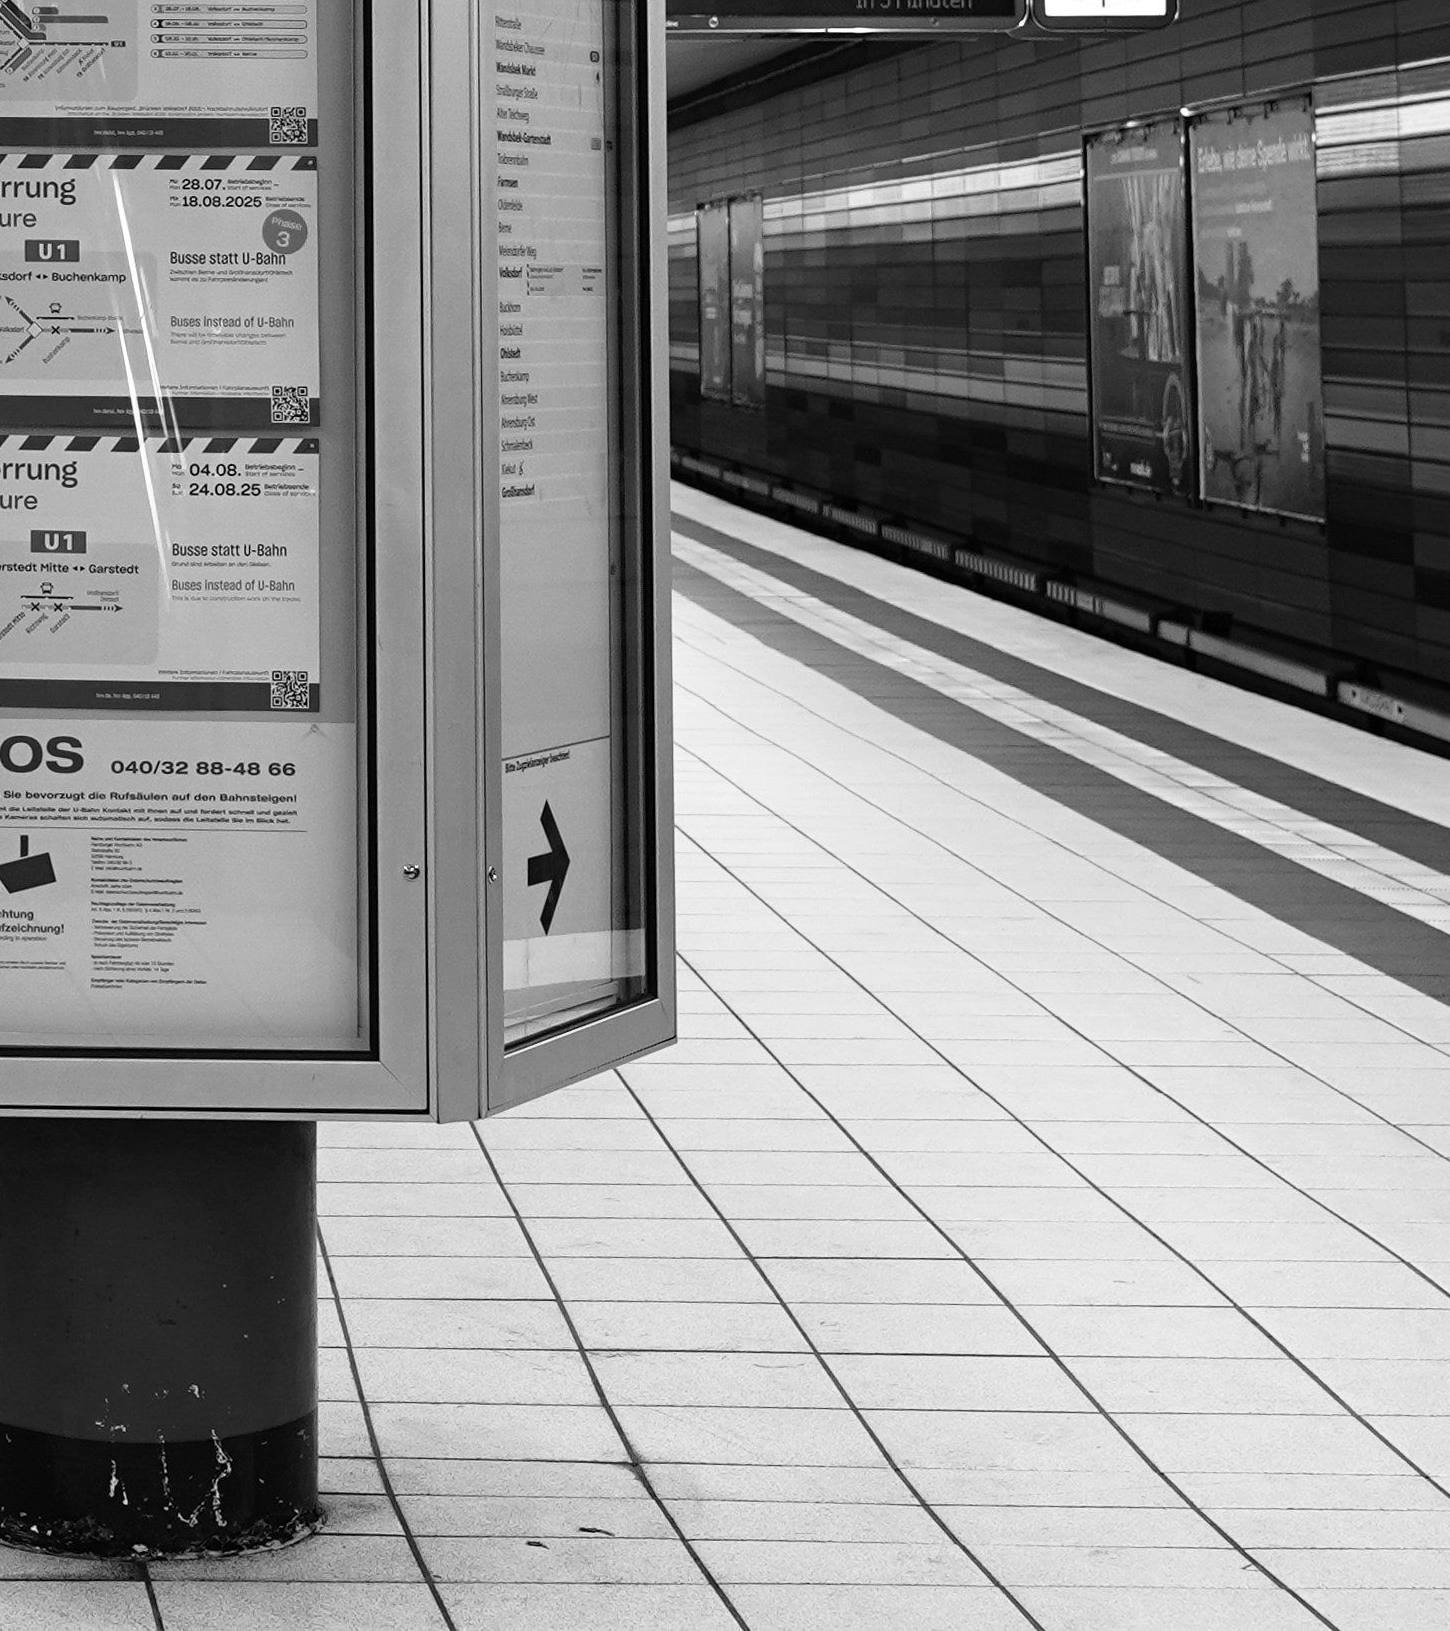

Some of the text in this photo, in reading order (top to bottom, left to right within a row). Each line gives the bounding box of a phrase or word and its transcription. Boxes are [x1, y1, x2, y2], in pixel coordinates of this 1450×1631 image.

[182, 178, 226, 190] 28.07.
[182, 196, 262, 208] 18.08.2025
[272, 215, 303, 232] Phase
[276, 232, 290, 248] 3
[38, 244, 66, 260] U1
[170, 251, 286, 266] Busse statt U-Bahn
[52, 272, 126, 284] Buchenkamp
[170, 316, 295, 328] Buses instead of U-Bahn
[189, 463, 242, 476] 04.08.
[188, 483, 262, 496] 24.08.25
[44, 534, 74, 551] U1
[172, 543, 288, 557] Busse statt U-Bahn
[40, 562, 70, 574] Mitte
[88, 564, 140, 574] Garstedt
[172, 579, 295, 592] Buses instead of U-Bahn
[110, 760, 296, 777] 040/32 88-48 66
[3, 790, 22, 799] Sie
[26, 790, 85, 802] bevorzugt
[88, 791, 106, 800] die
[110, 792, 168, 802] Rufsäulen
[172, 792, 190, 802] auf
[194, 792, 216, 802] den
[220, 793, 297, 804] Bahnsteigen!
